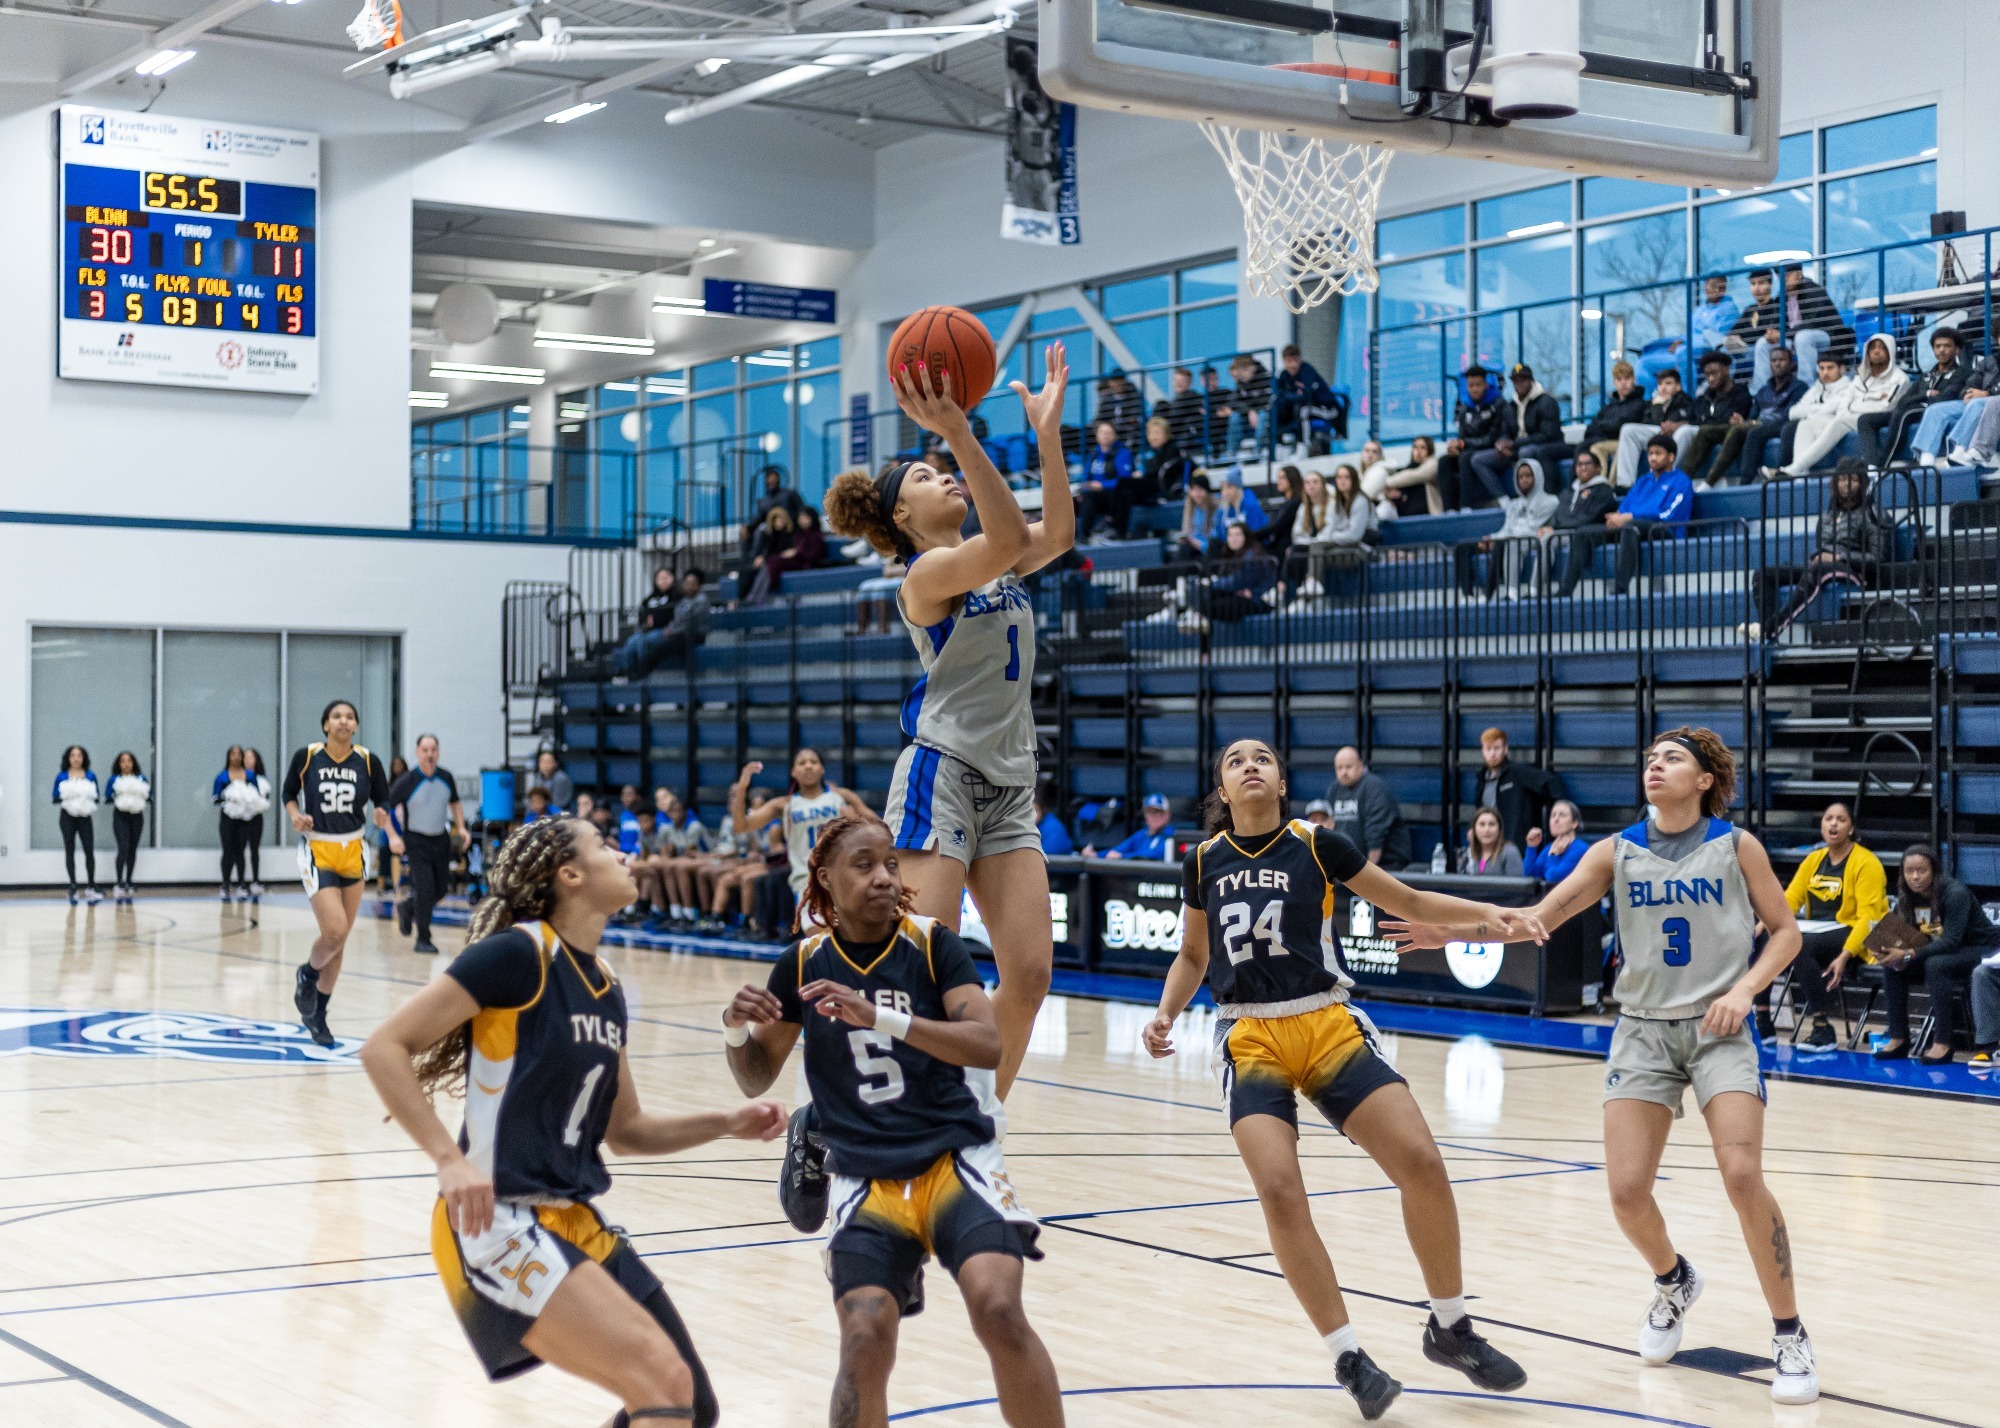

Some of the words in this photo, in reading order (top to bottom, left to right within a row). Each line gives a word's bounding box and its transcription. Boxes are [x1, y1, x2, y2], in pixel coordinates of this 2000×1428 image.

[146, 173, 219, 213] 55.5
[86, 206, 128, 227] BLINN
[174, 223, 213, 239] PERIOD
[91, 228, 132, 265] 30
[253, 222, 299, 243] TYLER
[194, 241, 203, 266] 1
[273, 245, 303, 276] 11
[79, 267, 107, 287] FLS
[155, 273, 191, 294] PLYR
[197, 277, 233, 298] FOUL
[89, 290, 106, 319] 3
[126, 293, 143, 322] 5
[277, 283, 304, 303] FLS
[162, 296, 198, 326] 03
[215, 302, 224, 327] 1
[242, 303, 259, 330] 4
[286, 305, 303, 334] 3
[1005, 624, 1020, 682] 1
[318, 767, 358, 783] TYLER
[318, 782, 357, 814] 32
[790, 806, 838, 824] BLINN
[1138, 882, 1177, 899] BLINN
[1216, 868, 1290, 898] TYLER
[1628, 877, 1723, 909] BLINN
[1219, 899, 1290, 967] 24
[1356, 937, 1397, 951] COLLEGE
[1662, 916, 1692, 968] 3
[847, 1028, 905, 1105] 5
[564, 1064, 605, 1147] 1
